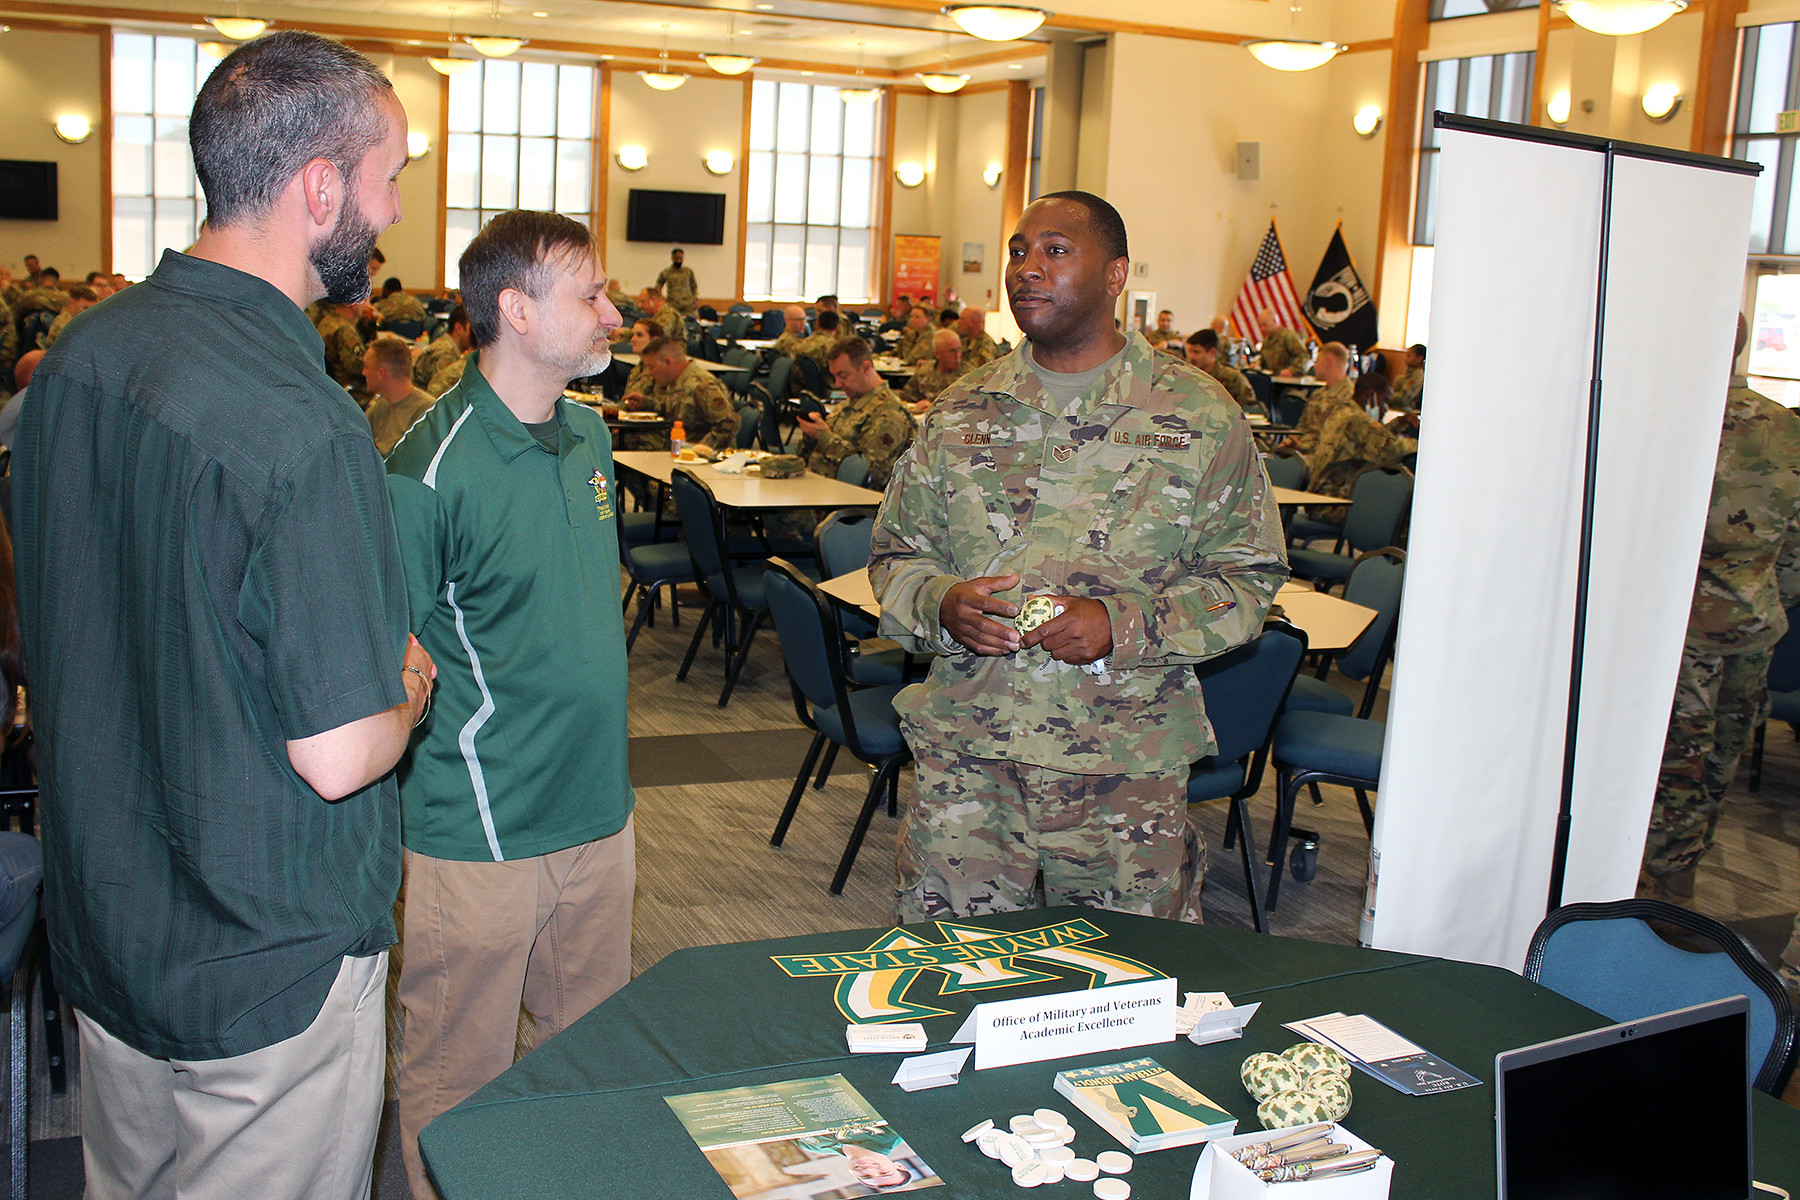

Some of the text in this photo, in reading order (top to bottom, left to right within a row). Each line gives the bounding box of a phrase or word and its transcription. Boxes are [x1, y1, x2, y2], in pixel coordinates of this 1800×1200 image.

[1779, 112, 1797, 130] EXIT
[963, 433, 992, 445] GLENN
[1113, 430, 1187, 449] U.S. AIR FORCE
[791, 924, 1094, 973] WAYNE STATE
[992, 996, 1162, 1029] Office of Military and Veterans
[1019, 1014, 1135, 1041] Academic Excellence
[1073, 1075, 1124, 1087] FRIENDLY
[1120, 1067, 1166, 1083] VETERAN
